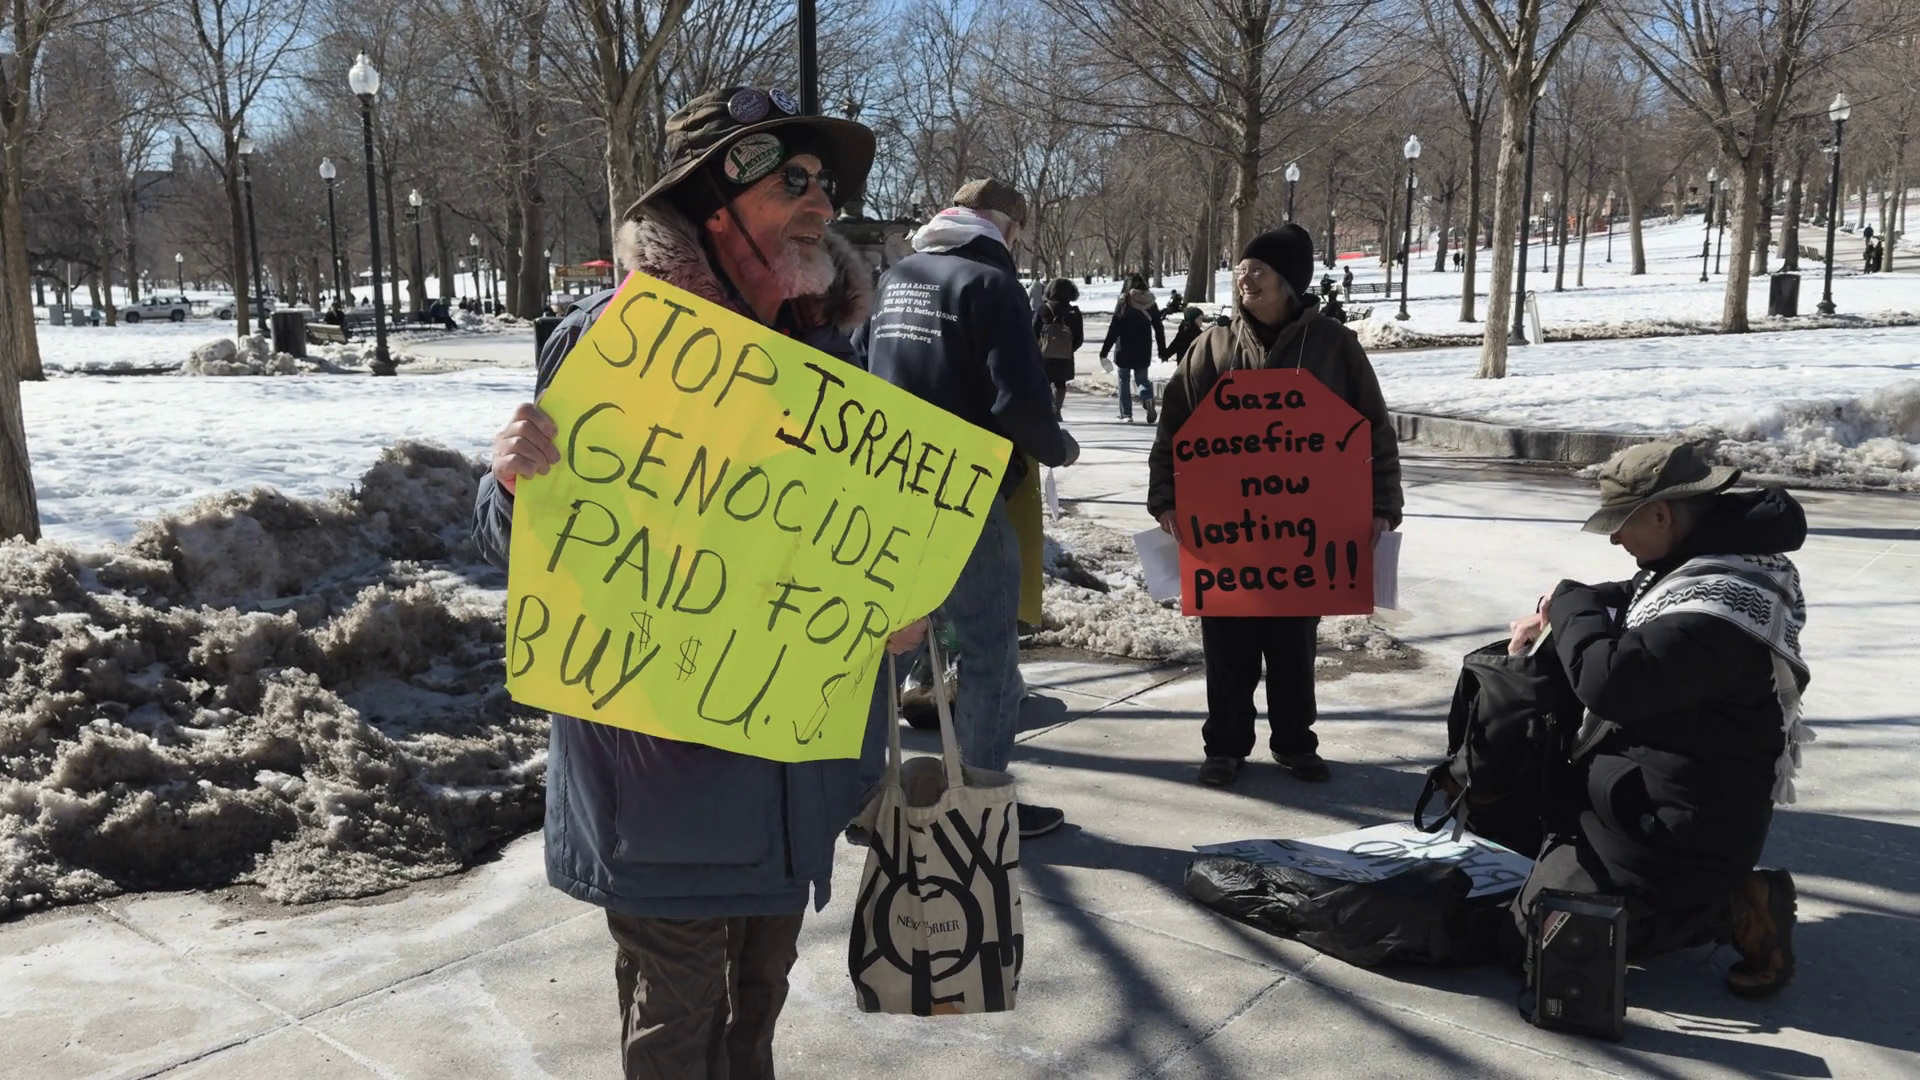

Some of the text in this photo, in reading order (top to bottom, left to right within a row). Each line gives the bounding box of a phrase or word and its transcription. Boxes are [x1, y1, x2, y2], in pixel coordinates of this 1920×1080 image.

[935, 310, 958, 322] USMC
[592, 291, 778, 408] STOP
[1214, 378, 1306, 411] Gaza
[1175, 421, 1326, 462] ceasefire
[1241, 475, 1310, 498] now
[1190, 508, 1316, 558] lasting
[546, 498, 890, 662] PAID FOR
[1195, 540, 1358, 610] peace!!
[896, 913, 960, 937] NEW ORKER
